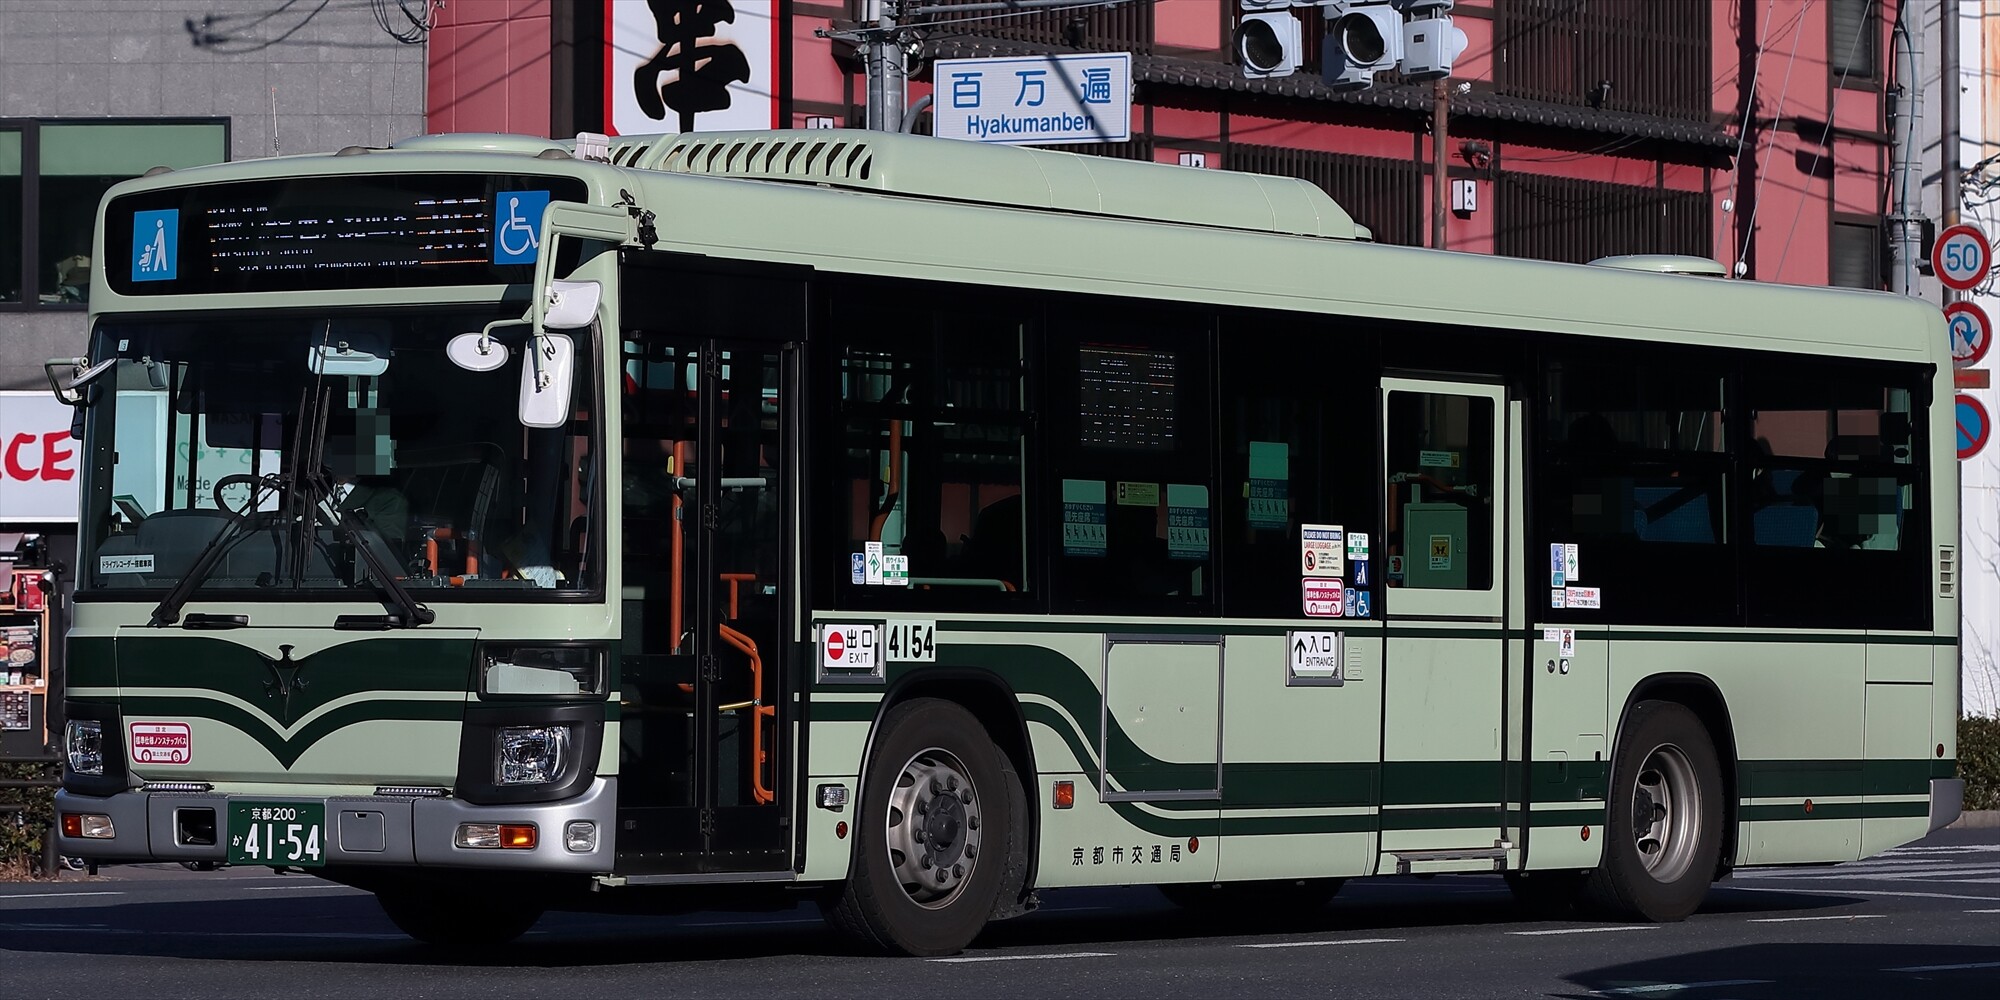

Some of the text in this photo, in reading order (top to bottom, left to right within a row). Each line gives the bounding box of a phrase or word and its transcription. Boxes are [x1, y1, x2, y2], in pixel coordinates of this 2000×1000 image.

[951, 67, 1111, 108] 百万遍
[967, 112, 1094, 137] Hyakumanben
[1946, 243, 1978, 272] 50
[0, 430, 75, 481] CE
[846, 629, 872, 648] 出口
[888, 625, 934, 658] 4154
[1309, 635, 1331, 654] 入口
[849, 652, 869, 664] EXIT
[1306, 656, 1334, 667] ENTRANCE
[232, 823, 321, 862] か 41-54
[1072, 844, 1182, 867] 京都市交通局
